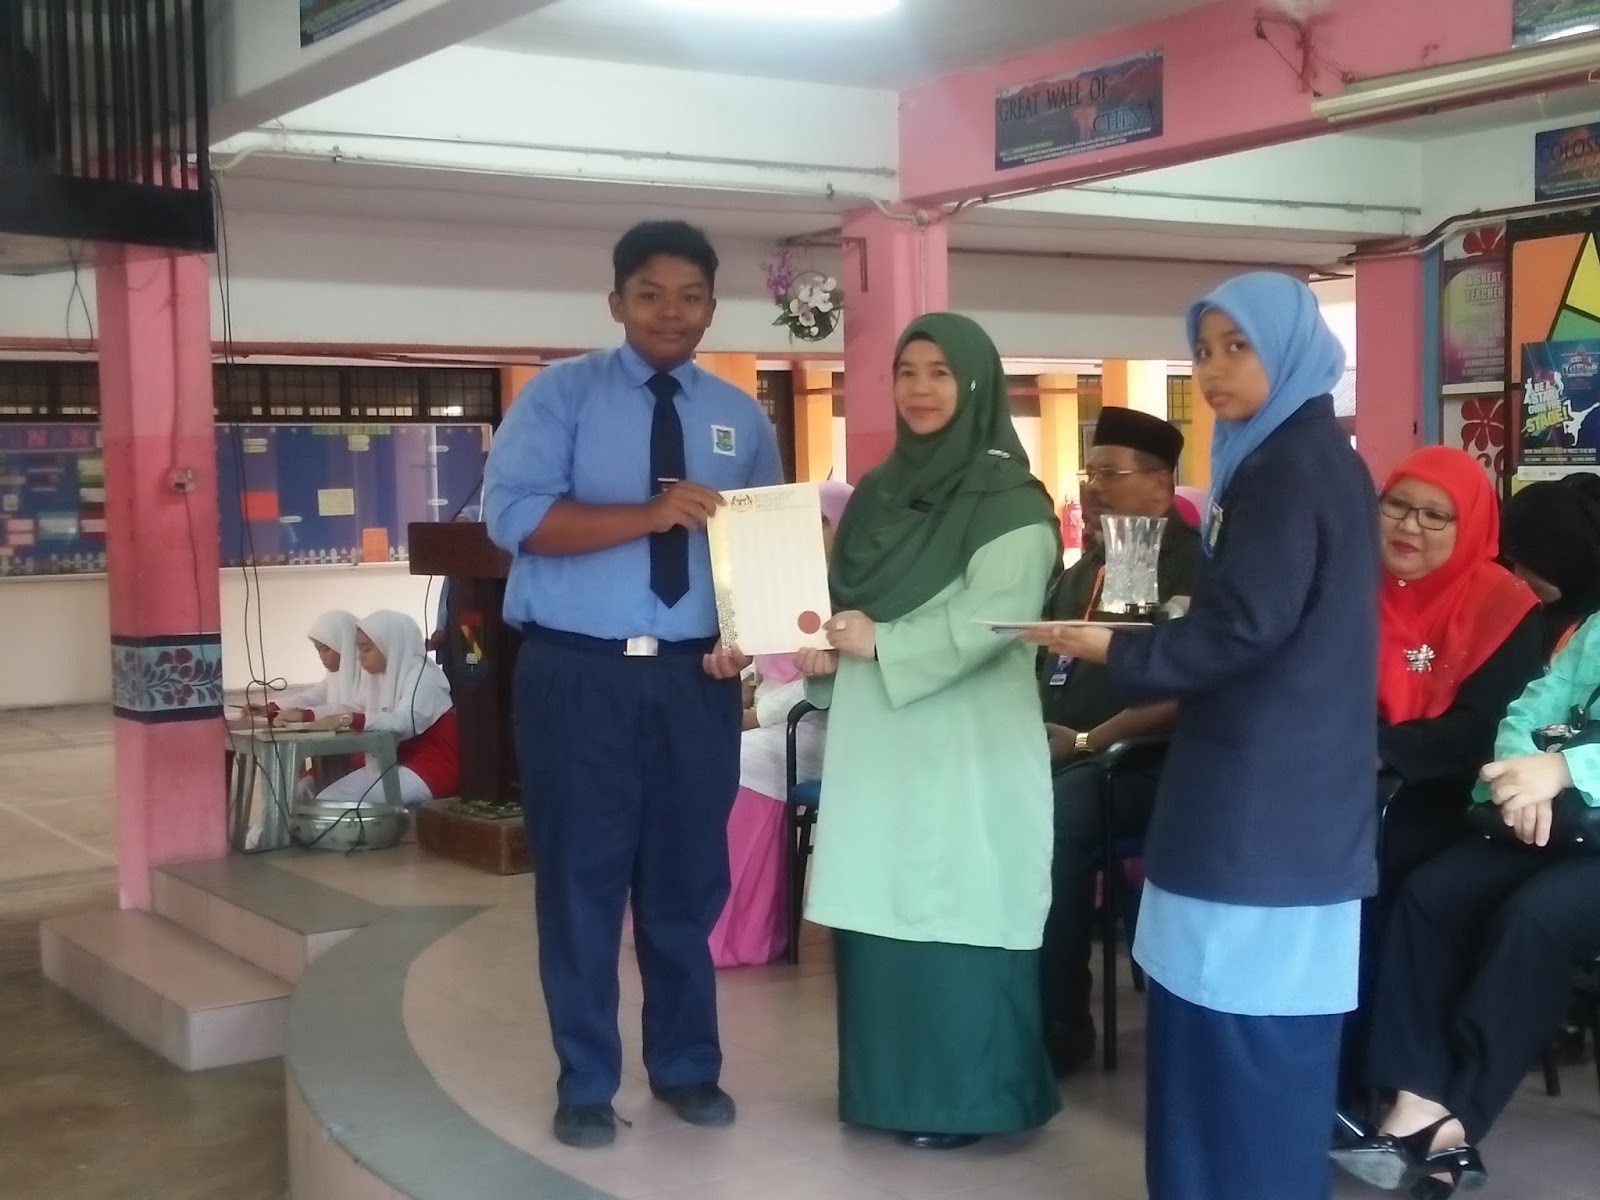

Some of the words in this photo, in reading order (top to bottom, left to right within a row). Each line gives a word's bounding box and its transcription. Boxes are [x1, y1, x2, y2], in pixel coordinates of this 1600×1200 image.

[1000, 92, 1039, 123] GREAT
[1047, 81, 1082, 110] WALL
[1089, 75, 1109, 101] OF
[1093, 101, 1154, 132] CHINA
[1474, 271, 1502, 286] GREAT
[1465, 286, 1504, 302] TEACHER
[1526, 406, 1568, 432] STAGE!
